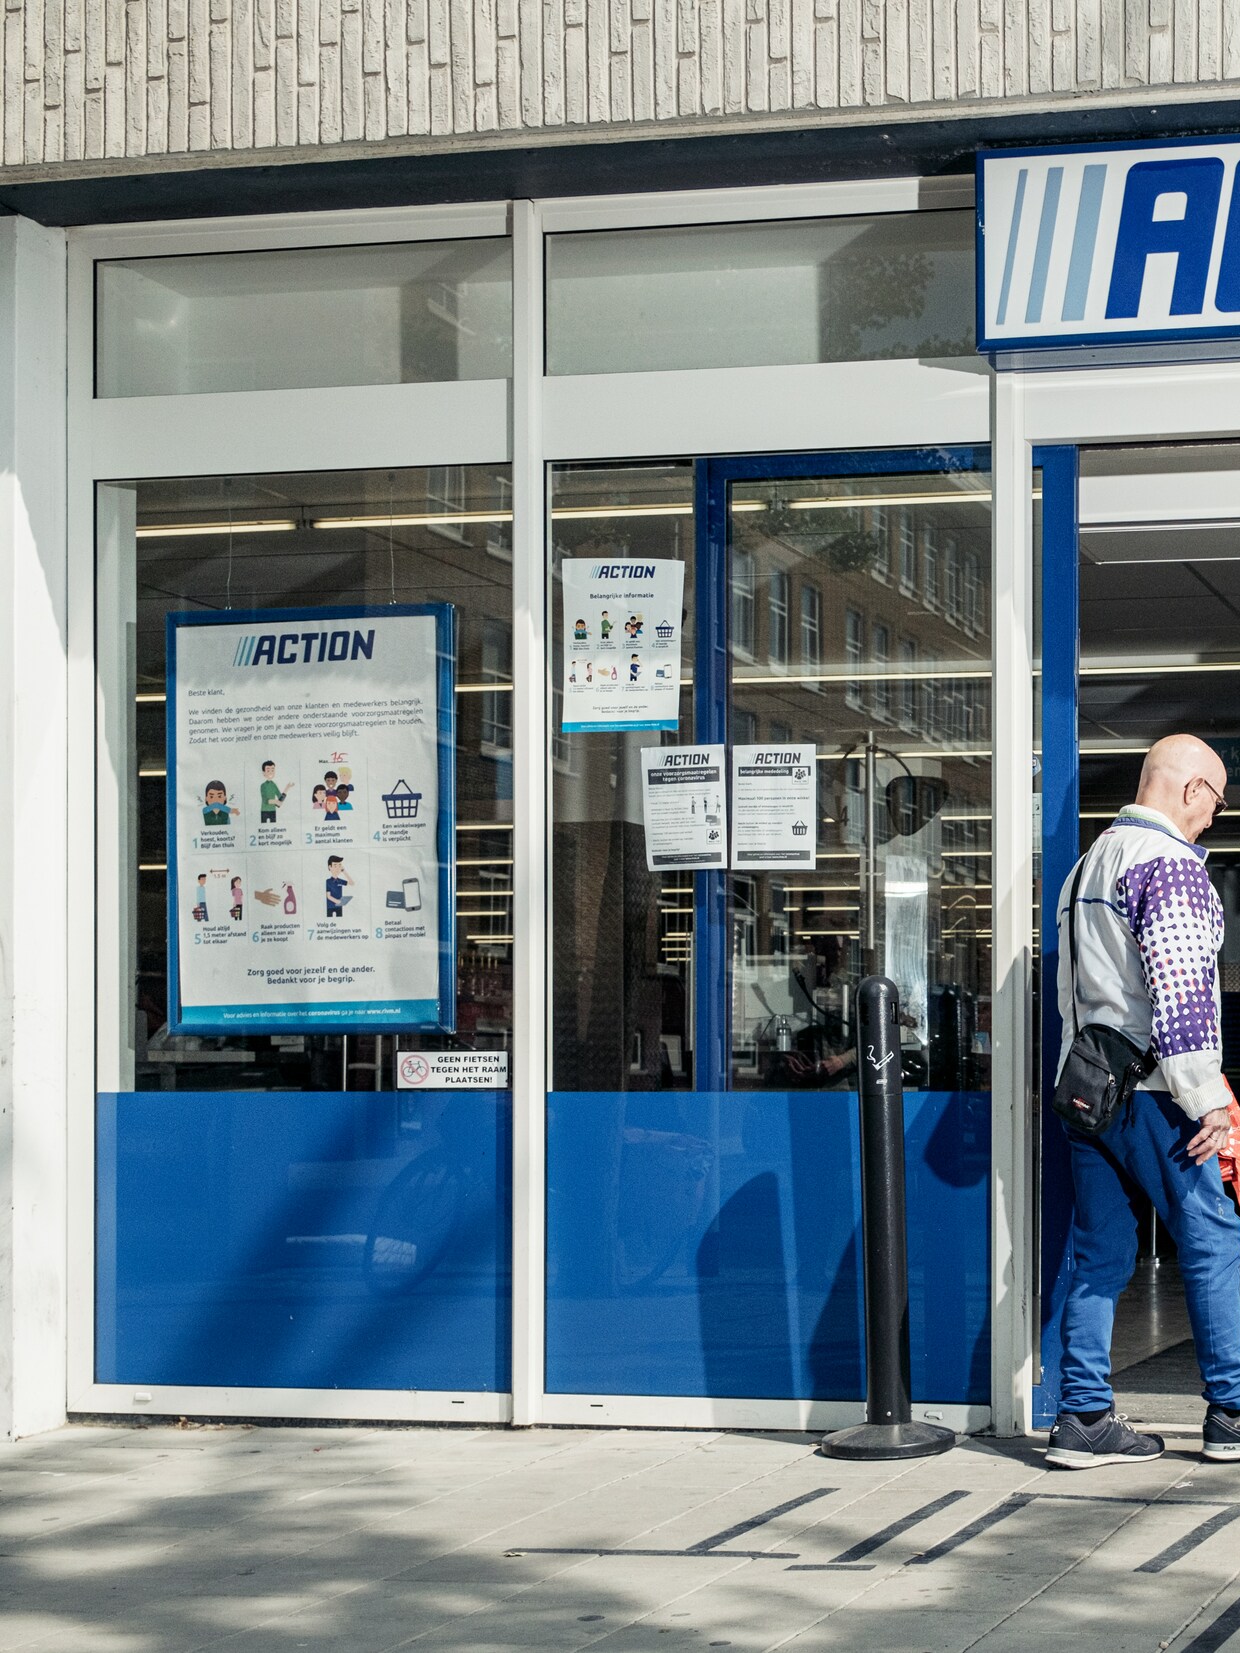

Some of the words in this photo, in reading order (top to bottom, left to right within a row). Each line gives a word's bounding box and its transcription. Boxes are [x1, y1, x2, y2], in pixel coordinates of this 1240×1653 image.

[598, 565, 656, 579] ACTION
[252, 629, 376, 666] ACTION
[188, 689, 206, 697] Beste
[208, 688, 225, 697] klant,
[188, 708, 199, 716] We
[201, 707, 222, 715] vinden
[236, 705, 271, 714] gezondheid
[343, 700, 388, 708] medewerkers
[217, 716, 240, 724] hebben
[303, 711, 347, 719] onderstaande
[351, 708, 423, 717] voorzorgsmaatregelen
[189, 727, 219, 736] genomen.
[234, 726, 255, 734] vragen
[276, 723, 281, 731] je
[314, 719, 387, 729] voorzorgsmaatregelen
[236, 734, 252, 743] jezelf
[279, 731, 322, 739] medewerkers
[323, 730, 340, 738] veilig
[342, 729, 359, 738] blijft.
[664, 753, 710, 766] ACTION
[755, 752, 801, 765] ACTION
[249, 835, 257, 846] 2
[305, 833, 313, 844] 3
[373, 830, 381, 841] 4
[252, 931, 259, 943] 6
[307, 929, 314, 940] 7
[375, 927, 383, 938] 8
[194, 933, 201, 944] 5
[247, 968, 264, 977] Zorg
[266, 967, 284, 977] goed
[286, 967, 302, 975] voor
[304, 966, 326, 975] jezelf
[339, 965, 349, 973] de
[351, 965, 375, 973] ander.
[267, 977, 298, 985] Bedankt
[318, 975, 325, 984] je
[328, 974, 355, 984] begrip.
[437, 1055, 461, 1063] GEEN
[463, 1055, 500, 1063] FIETSEN
[482, 1065, 507, 1073] RAAM
[445, 1076, 493, 1084] PLAATSEN!
